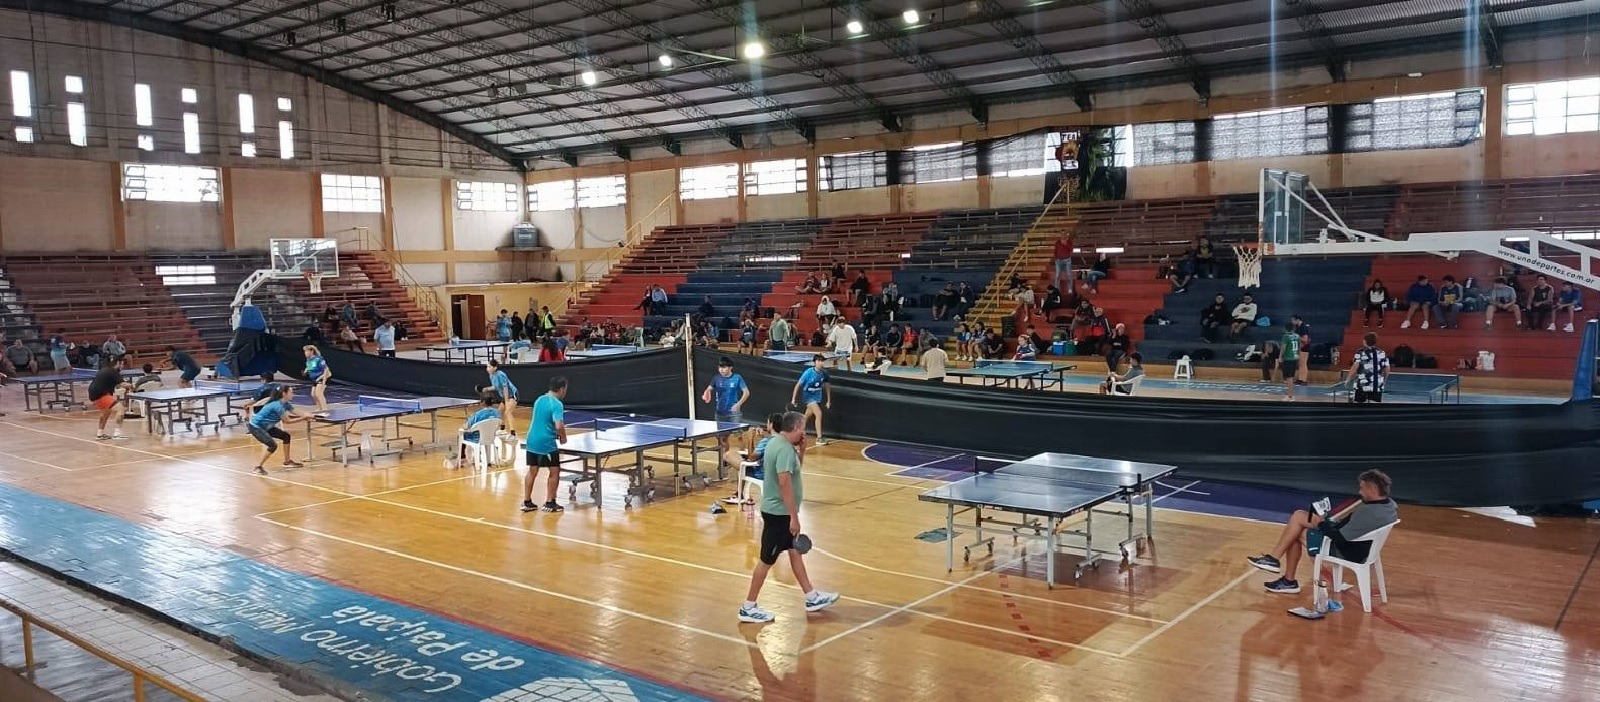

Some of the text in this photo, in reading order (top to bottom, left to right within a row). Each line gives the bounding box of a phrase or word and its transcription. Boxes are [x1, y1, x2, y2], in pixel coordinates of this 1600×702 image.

[1498, 249, 1595, 285] www.unodeportes.com.ar
[300, 628, 463, 693] Gobierno
[321, 605, 525, 671] de Paipalá
